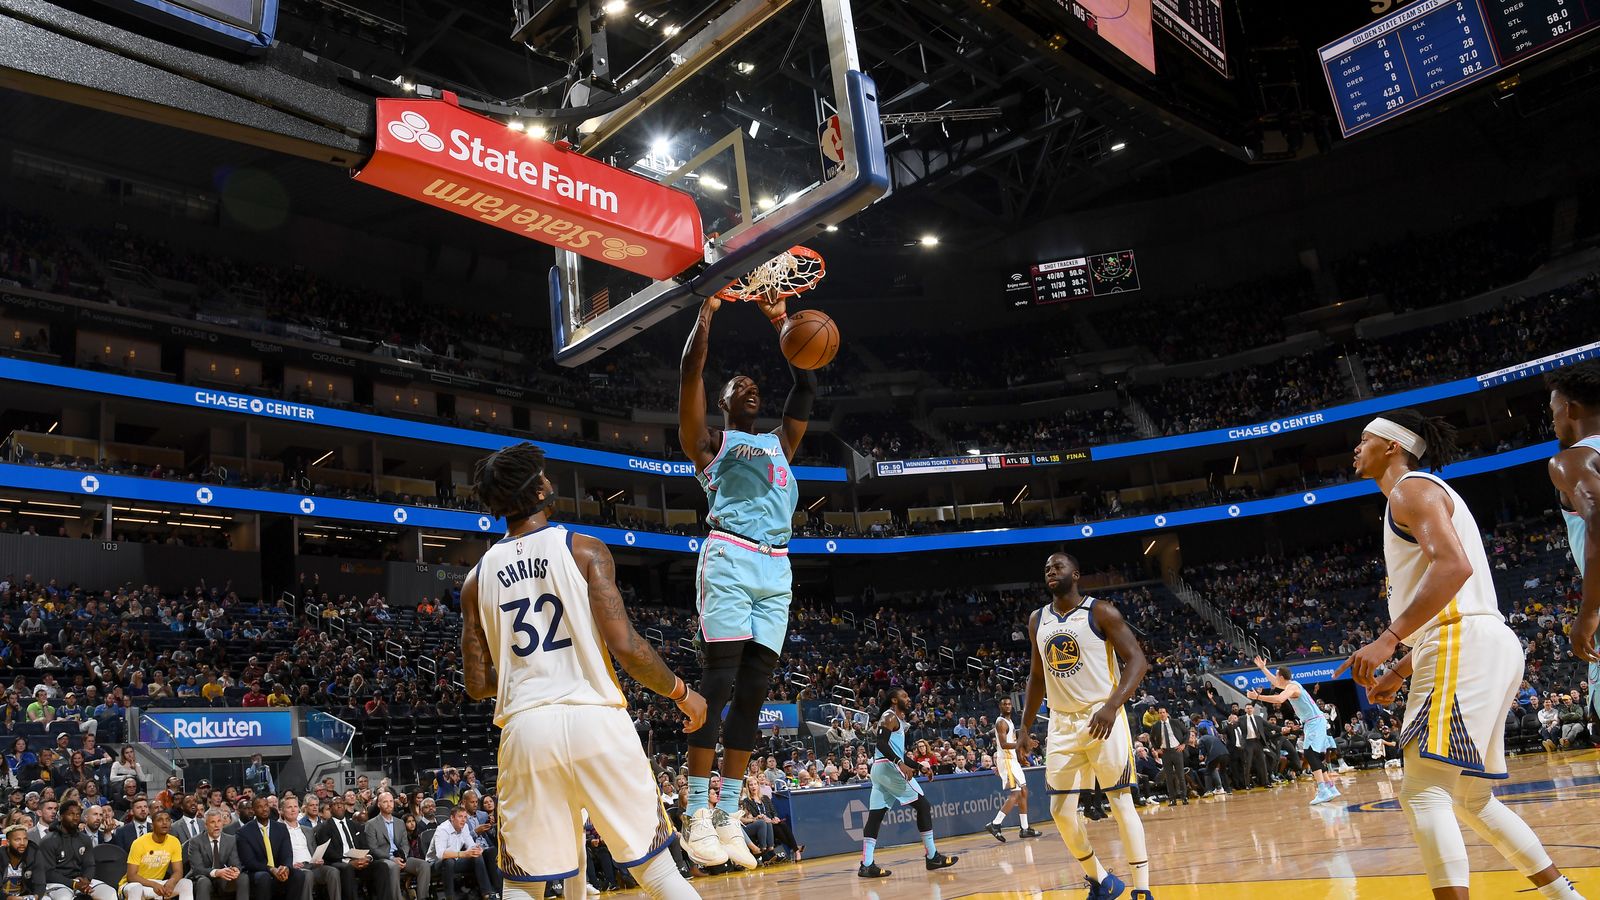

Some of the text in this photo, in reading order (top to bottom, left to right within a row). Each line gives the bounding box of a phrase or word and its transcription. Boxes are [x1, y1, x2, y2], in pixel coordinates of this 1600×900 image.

[1072, 3, 1085, 22] 105
[1412, 2, 1463, 31] BLK 2
[1503, 2, 1524, 15] DREB
[1352, 29, 1378, 45] GOLDEN
[1377, 19, 1398, 33] STATE
[1397, 10, 1417, 24] TEAM
[1417, 0, 1439, 14] STATS
[1416, 14, 1467, 42] TO 14
[1507, 18, 1522, 27] STL
[1511, 9, 1568, 39] 2P% 58.0
[1419, 25, 1471, 54] POT 9
[1515, 21, 1572, 52] 3P% 36.7
[1340, 38, 1387, 65] AST 21
[1343, 50, 1390, 77] OREB 6
[1423, 38, 1474, 66] PITP 28
[1426, 49, 1478, 77] FG% 37.0
[1346, 61, 1394, 88] DREB 31
[1350, 73, 1397, 99] STL 8
[1430, 61, 1482, 89] FT% 88.2
[1353, 84, 1401, 110] 2P% 42.9
[1356, 96, 1404, 122] 3P% 29.0
[1050, 281, 1066, 289] 11/30
[2, 294, 65, 312] Google Cloud
[171, 326, 208, 339] CHASE
[250, 341, 283, 353] Rakuten
[312, 353, 356, 367] ORACLE
[496, 386, 522, 398] verizon
[195, 391, 315, 420] CHASE CENTER
[1228, 413, 1323, 439] CHASE CENTER
[731, 444, 782, 461] Miami
[1066, 452, 1086, 460] FINAL
[628, 458, 696, 474] CHASE CENT
[767, 463, 788, 488] 13
[102, 543, 118, 551] 103
[497, 558, 549, 588] CHRISS
[499, 593, 573, 657] 32
[1043, 629, 1079, 643] GOLDEN STATE
[1062, 641, 1075, 653] 23
[1048, 661, 1084, 679] WARRIORS
[173, 716, 262, 740] Rakuten
